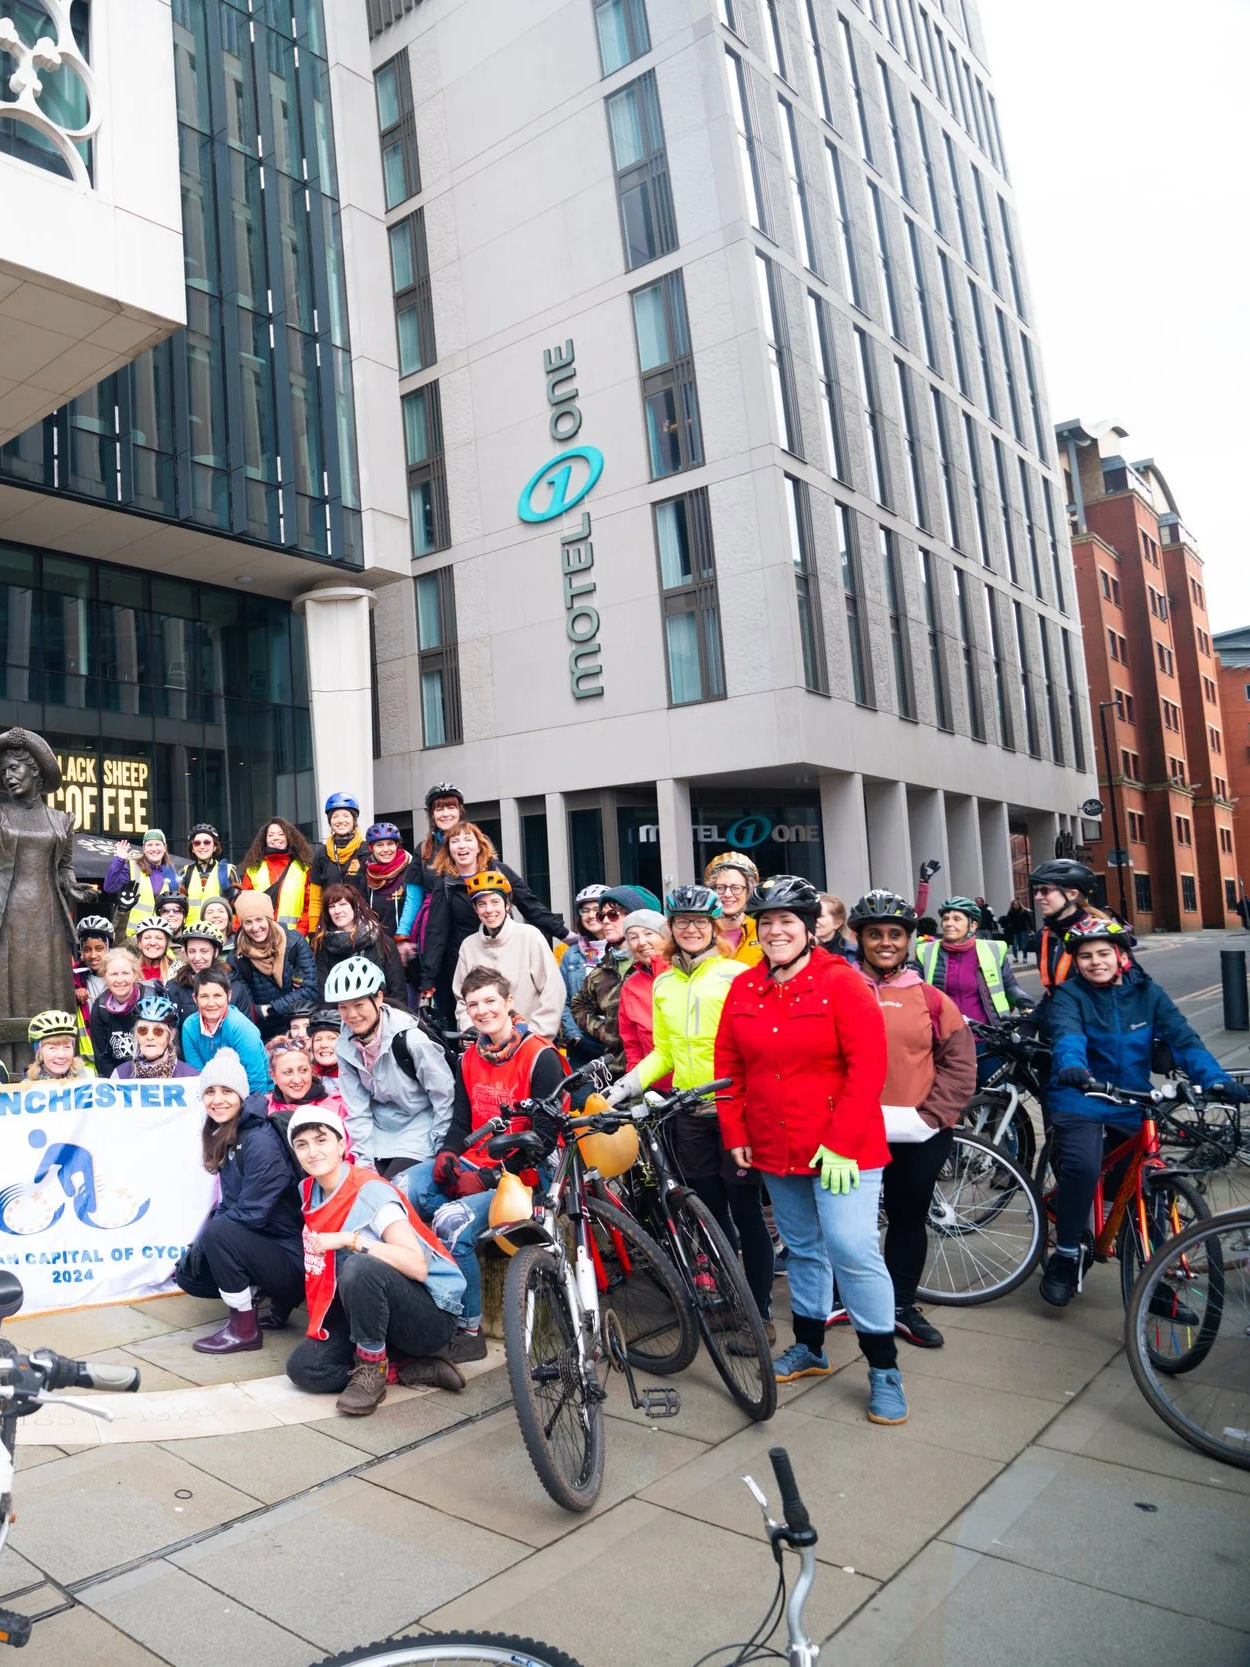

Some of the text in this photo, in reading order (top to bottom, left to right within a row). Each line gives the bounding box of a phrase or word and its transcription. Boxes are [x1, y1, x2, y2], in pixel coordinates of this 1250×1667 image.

[57, 755, 148, 787] LACK SHEEP
[25, 1250, 104, 1266] CAPITAL
[111, 1248, 134, 1261] OF
[52, 1268, 94, 1284] 2024
